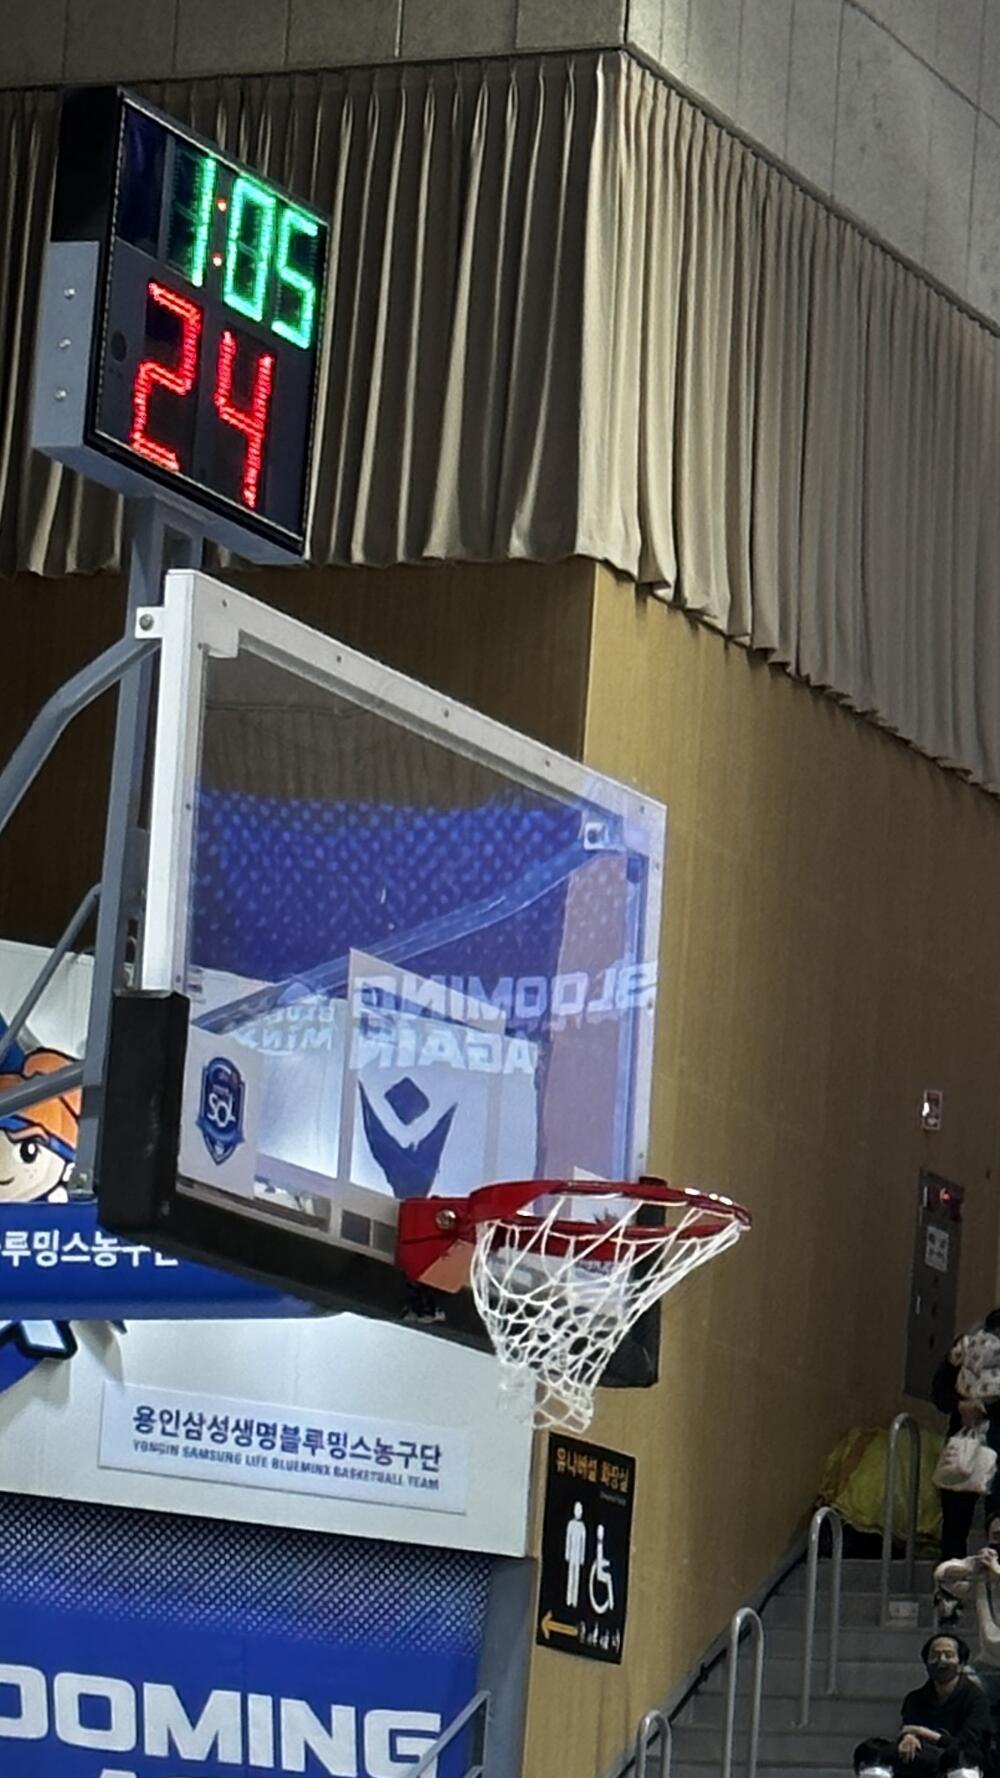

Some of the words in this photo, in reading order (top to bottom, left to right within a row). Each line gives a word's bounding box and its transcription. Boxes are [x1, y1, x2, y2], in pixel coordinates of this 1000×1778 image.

[131, 281, 273, 509] 24
[132, 1404, 442, 1474] 용인삼성생명블루밍스농구단
[182, 1445, 242, 1466] SAMSUNG
[245, 1454, 269, 1469] LIFE
[408, 1474, 440, 1491] TEAM
